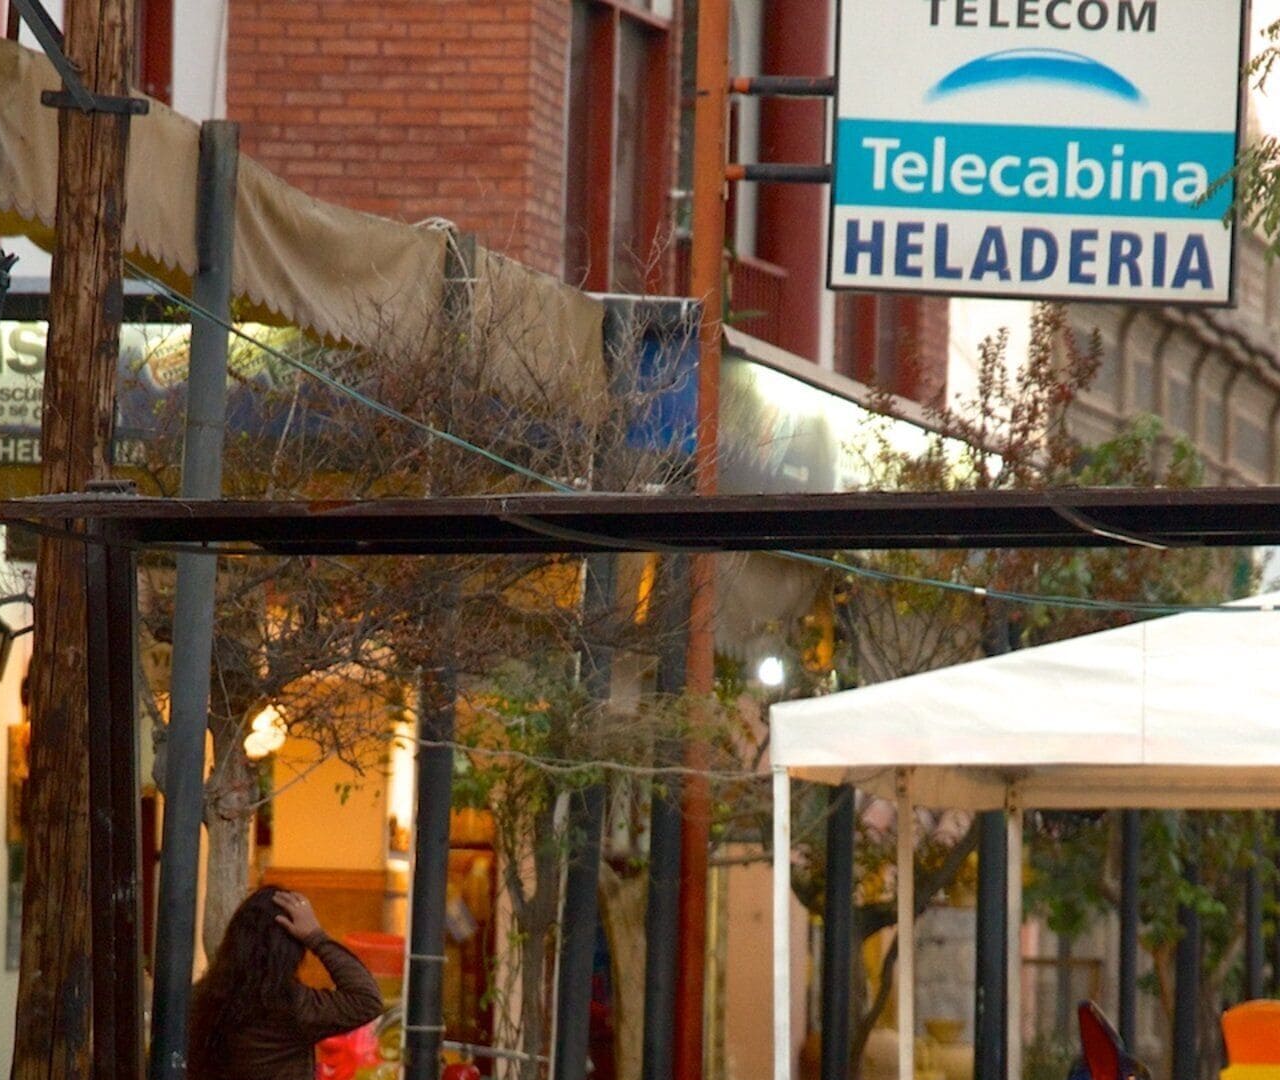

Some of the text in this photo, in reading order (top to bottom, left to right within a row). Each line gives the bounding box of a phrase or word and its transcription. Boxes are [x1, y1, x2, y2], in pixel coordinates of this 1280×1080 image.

[925, 0, 1158, 32] TELECOM
[861, 135, 1210, 203] Telecabina
[843, 218, 1215, 290] HELADERIA
